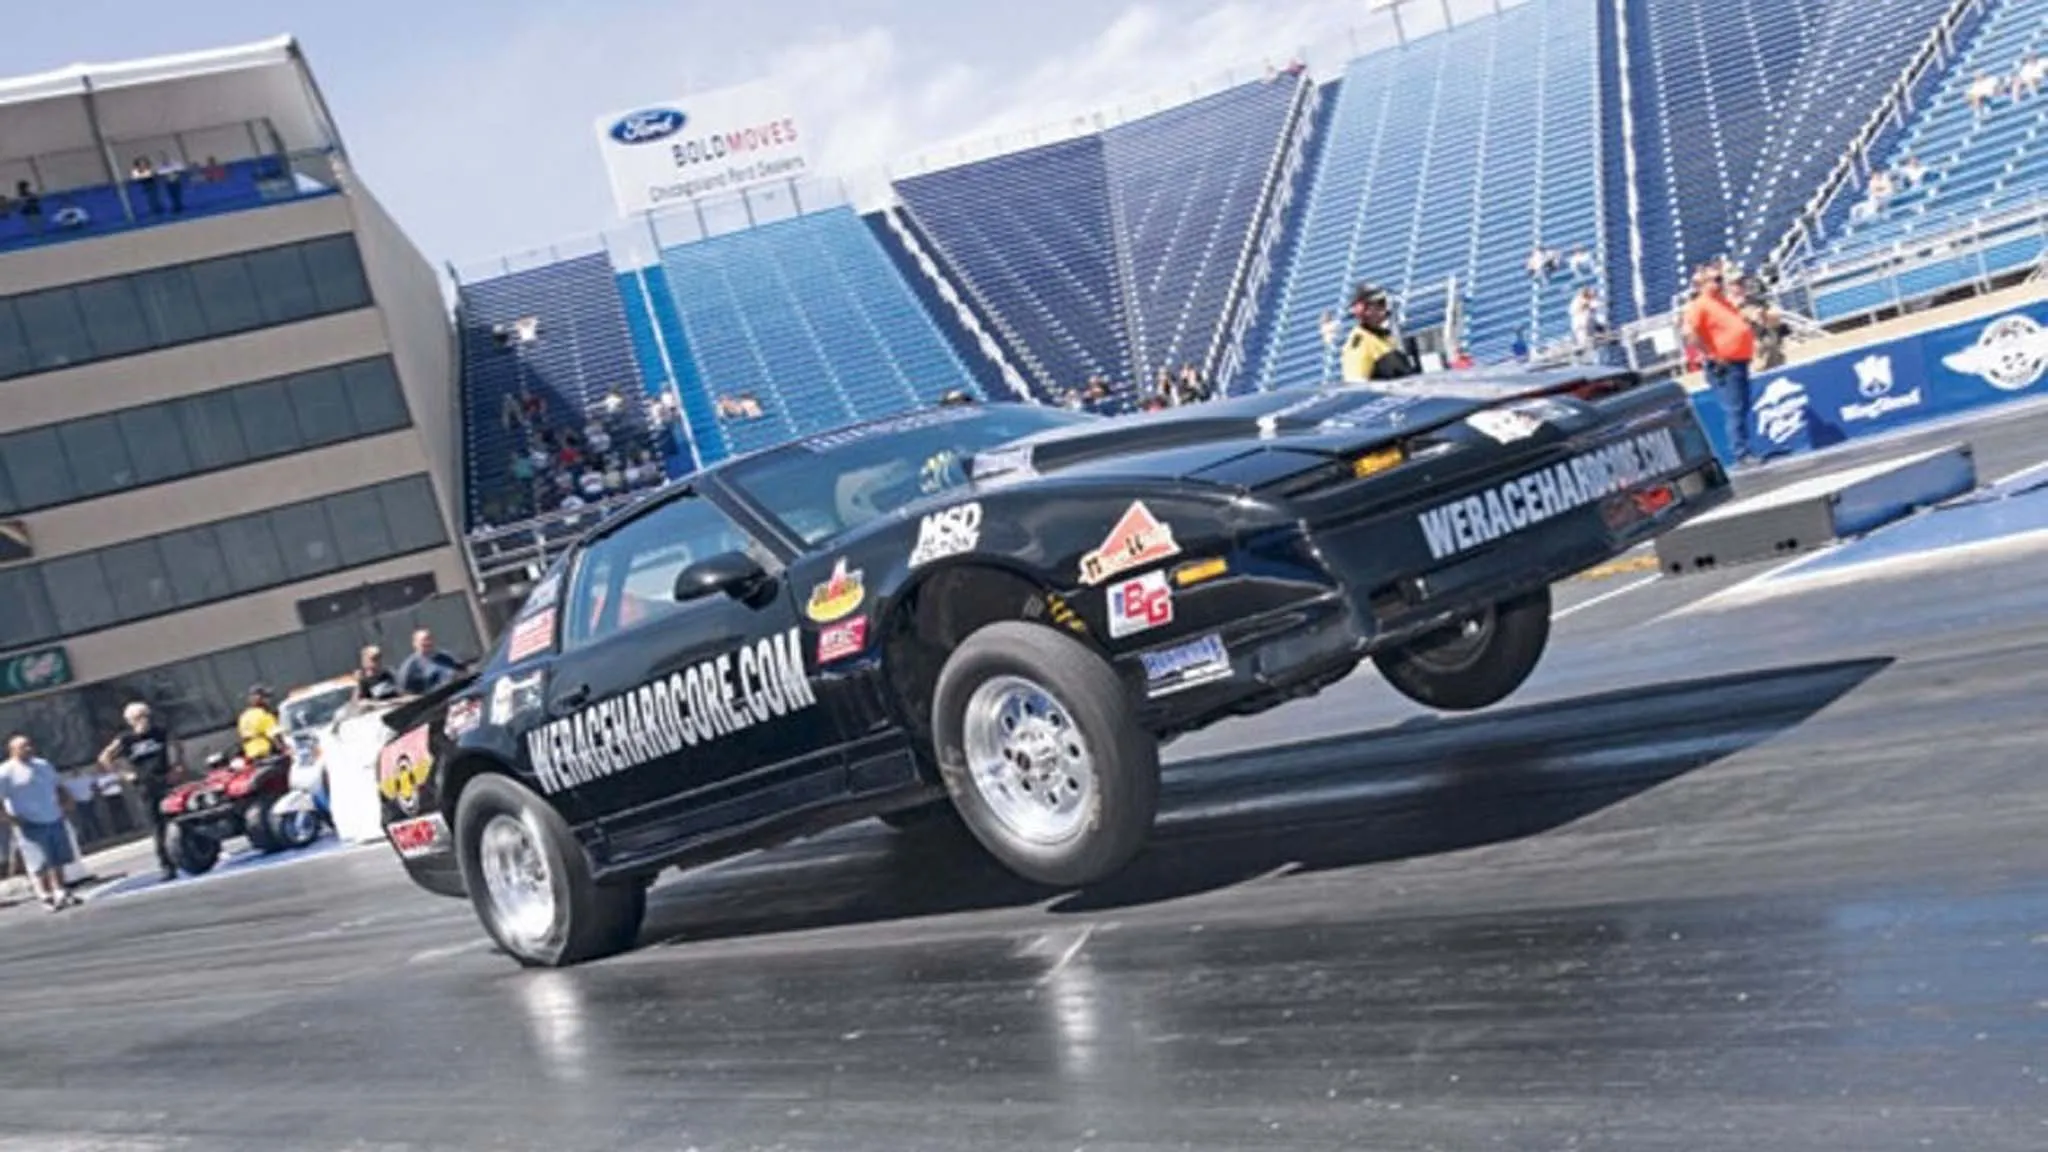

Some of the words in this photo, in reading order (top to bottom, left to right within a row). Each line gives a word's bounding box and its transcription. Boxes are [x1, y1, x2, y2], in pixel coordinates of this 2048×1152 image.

[620, 110, 674, 141] Ford
[1418, 428, 1681, 559] WERACEHARDCORE.COM
[920, 502, 983, 538] MSD
[1123, 582, 1171, 624] BG
[527, 626, 816, 794] WERACEHARDCORE.COM
